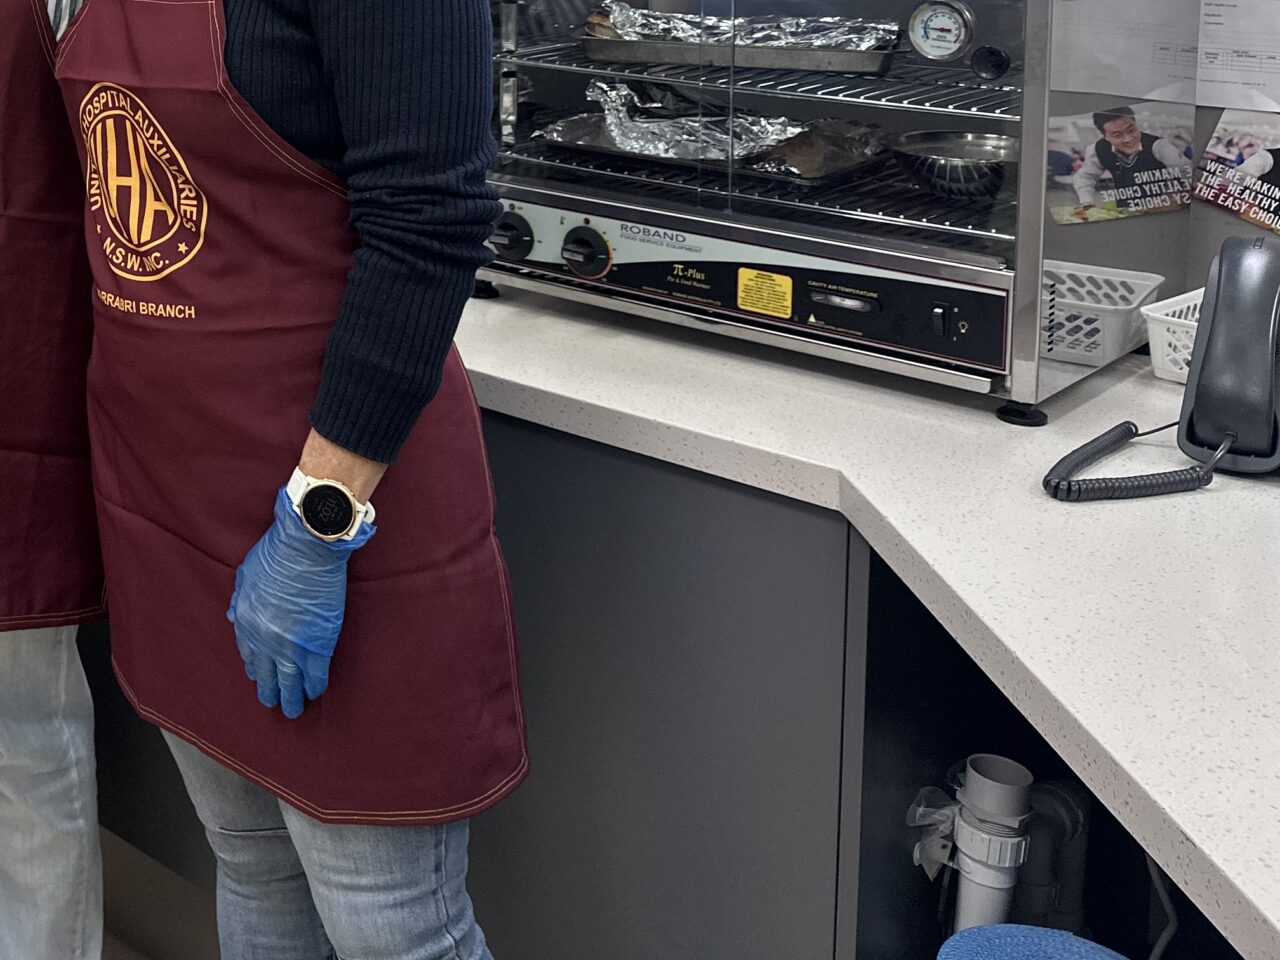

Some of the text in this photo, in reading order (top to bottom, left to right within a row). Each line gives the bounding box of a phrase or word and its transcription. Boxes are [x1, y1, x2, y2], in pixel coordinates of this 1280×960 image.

[1206, 160, 1243, 183] WE'RE
[1195, 183, 1219, 201] THE
[1218, 193, 1249, 213] EASY
[1200, 172, 1279, 212] THE HEALTHY
[620, 224, 686, 243] ROBAND
[839, 286, 879, 298] TEMPERATURE
[140, 302, 196, 318] BRANCH
